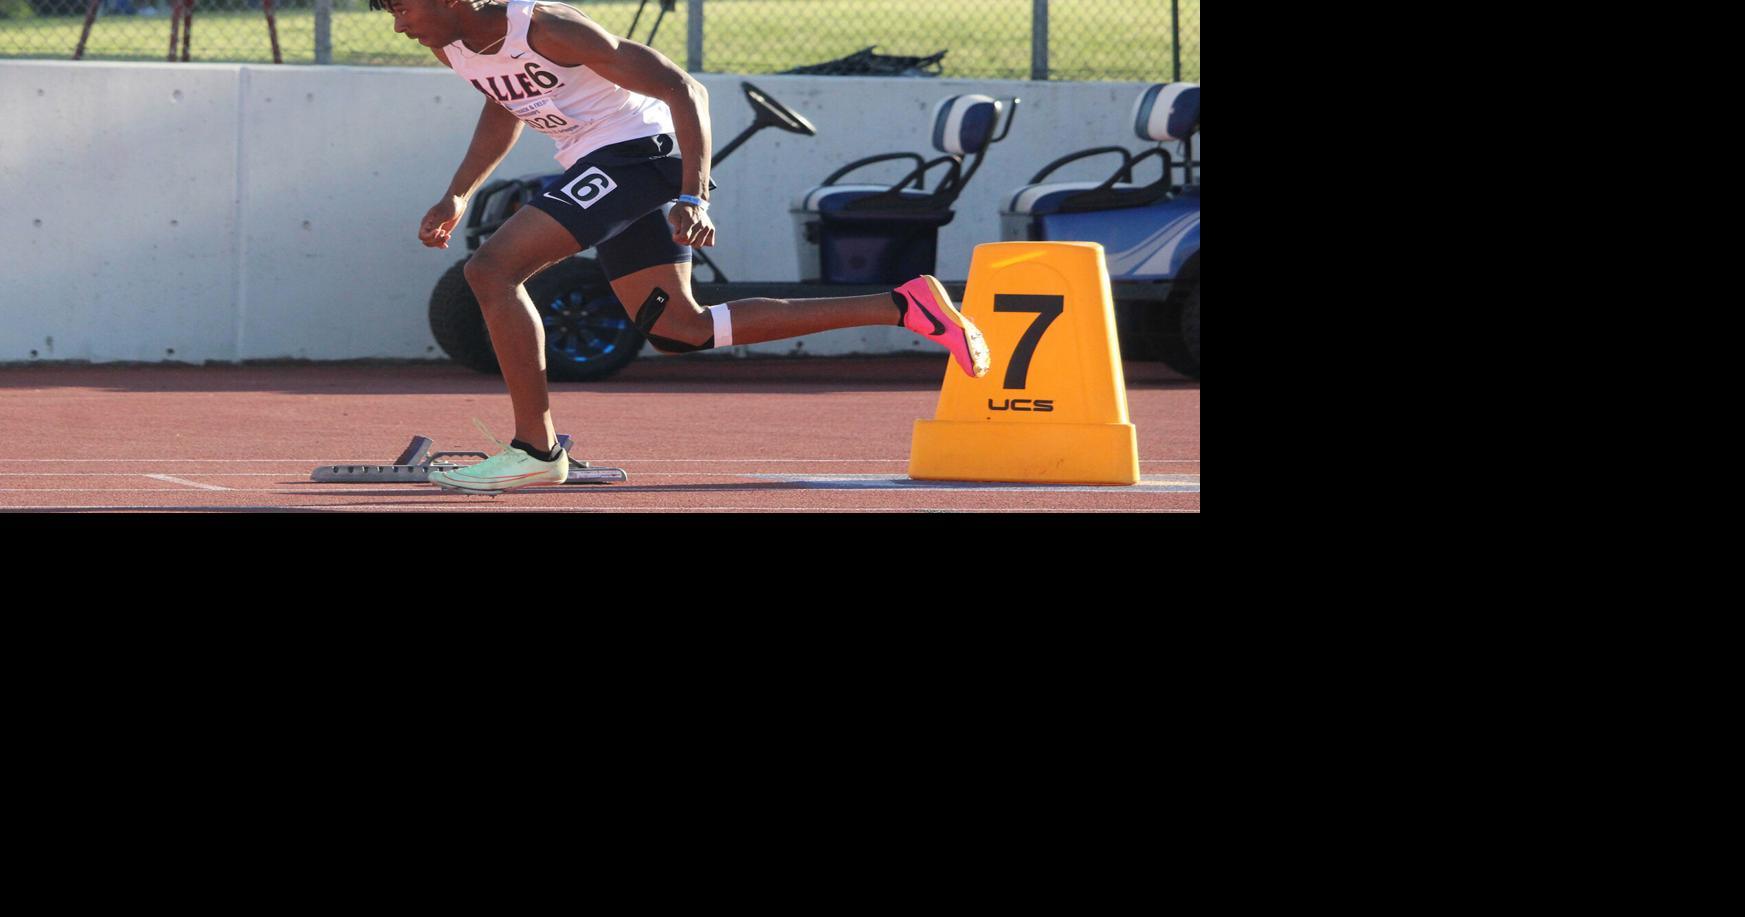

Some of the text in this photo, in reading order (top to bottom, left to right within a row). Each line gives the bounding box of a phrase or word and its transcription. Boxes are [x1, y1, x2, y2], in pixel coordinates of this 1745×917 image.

[524, 62, 559, 89] 6
[571, 173, 610, 202] 6
[993, 293, 1064, 390] 7
[988, 398, 1054, 412] UCS
